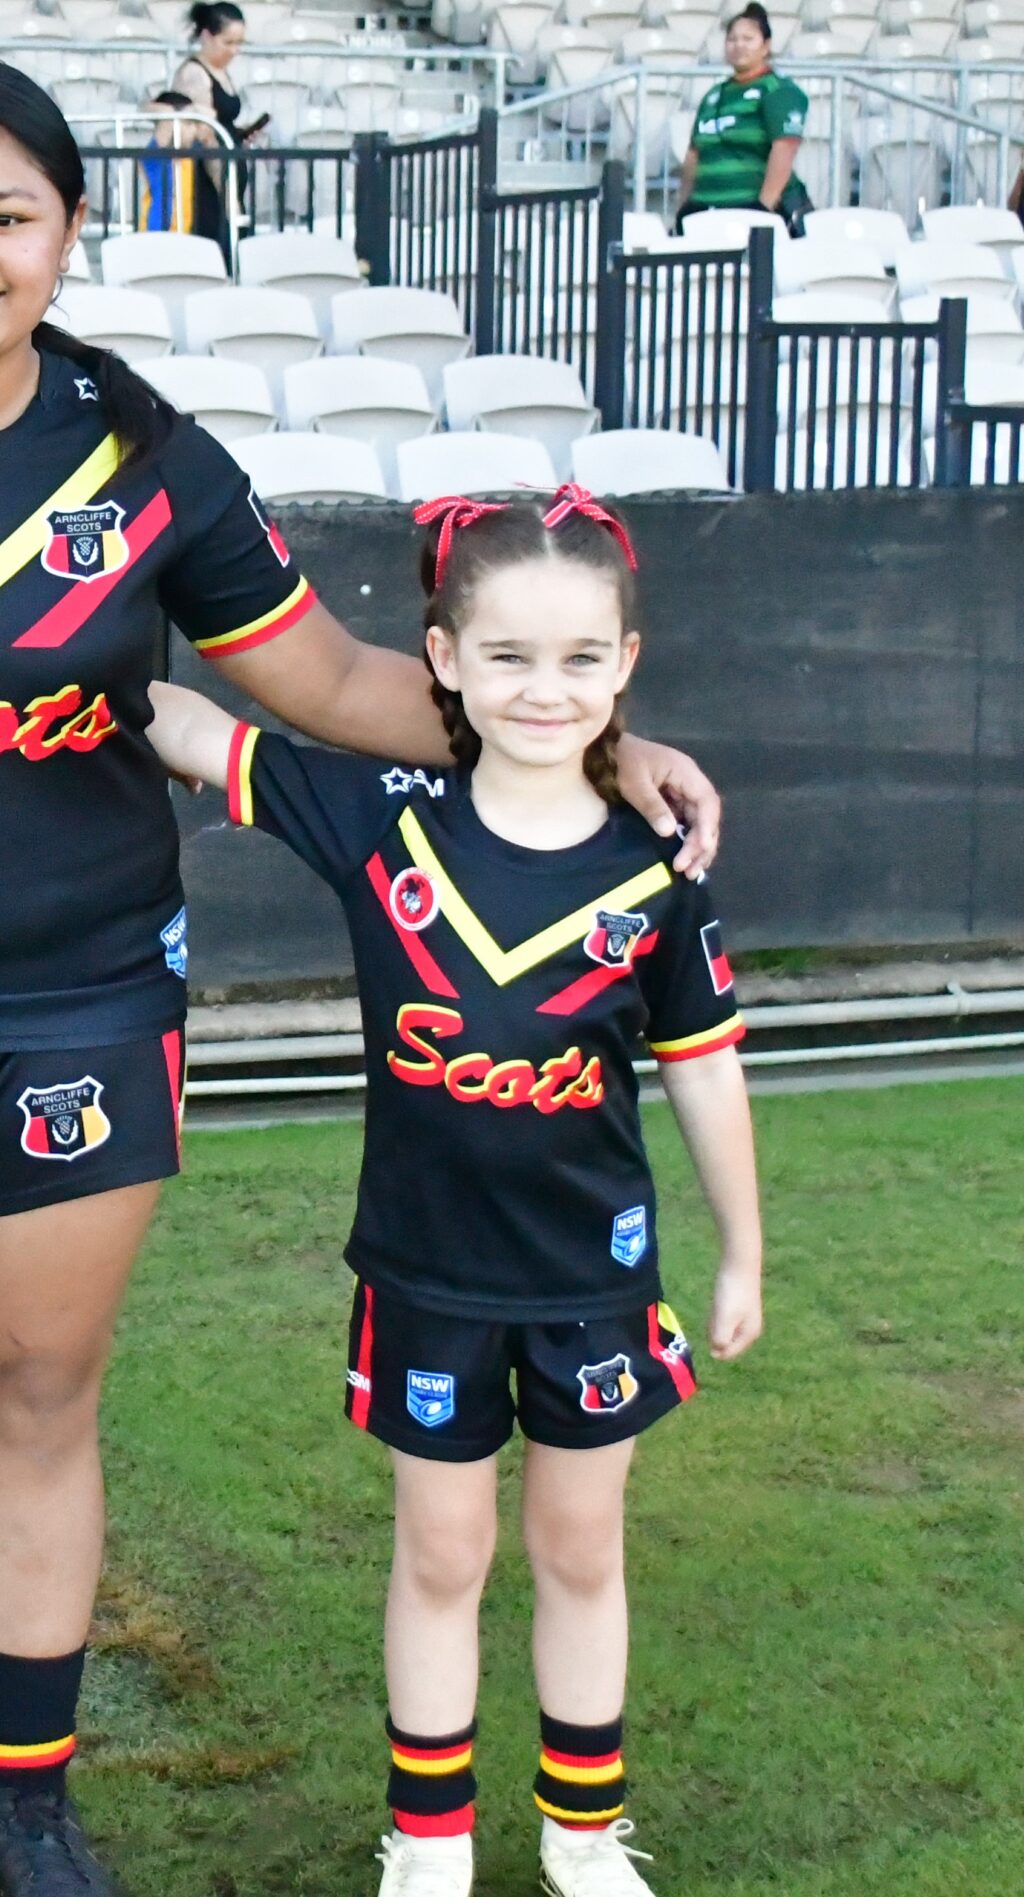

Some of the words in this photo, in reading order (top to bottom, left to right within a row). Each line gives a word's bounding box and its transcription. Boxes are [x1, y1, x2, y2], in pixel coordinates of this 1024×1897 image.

[54, 511, 112, 525] ARNCLIFFE
[66, 522, 102, 533] SCOTS
[387, 1003, 604, 1114] Scots
[31, 1087, 90, 1106] ARNCLIFFE
[43, 1099, 81, 1114] SCOTS
[617, 1210, 643, 1231] NSW
[410, 1374, 450, 1393] NSW
